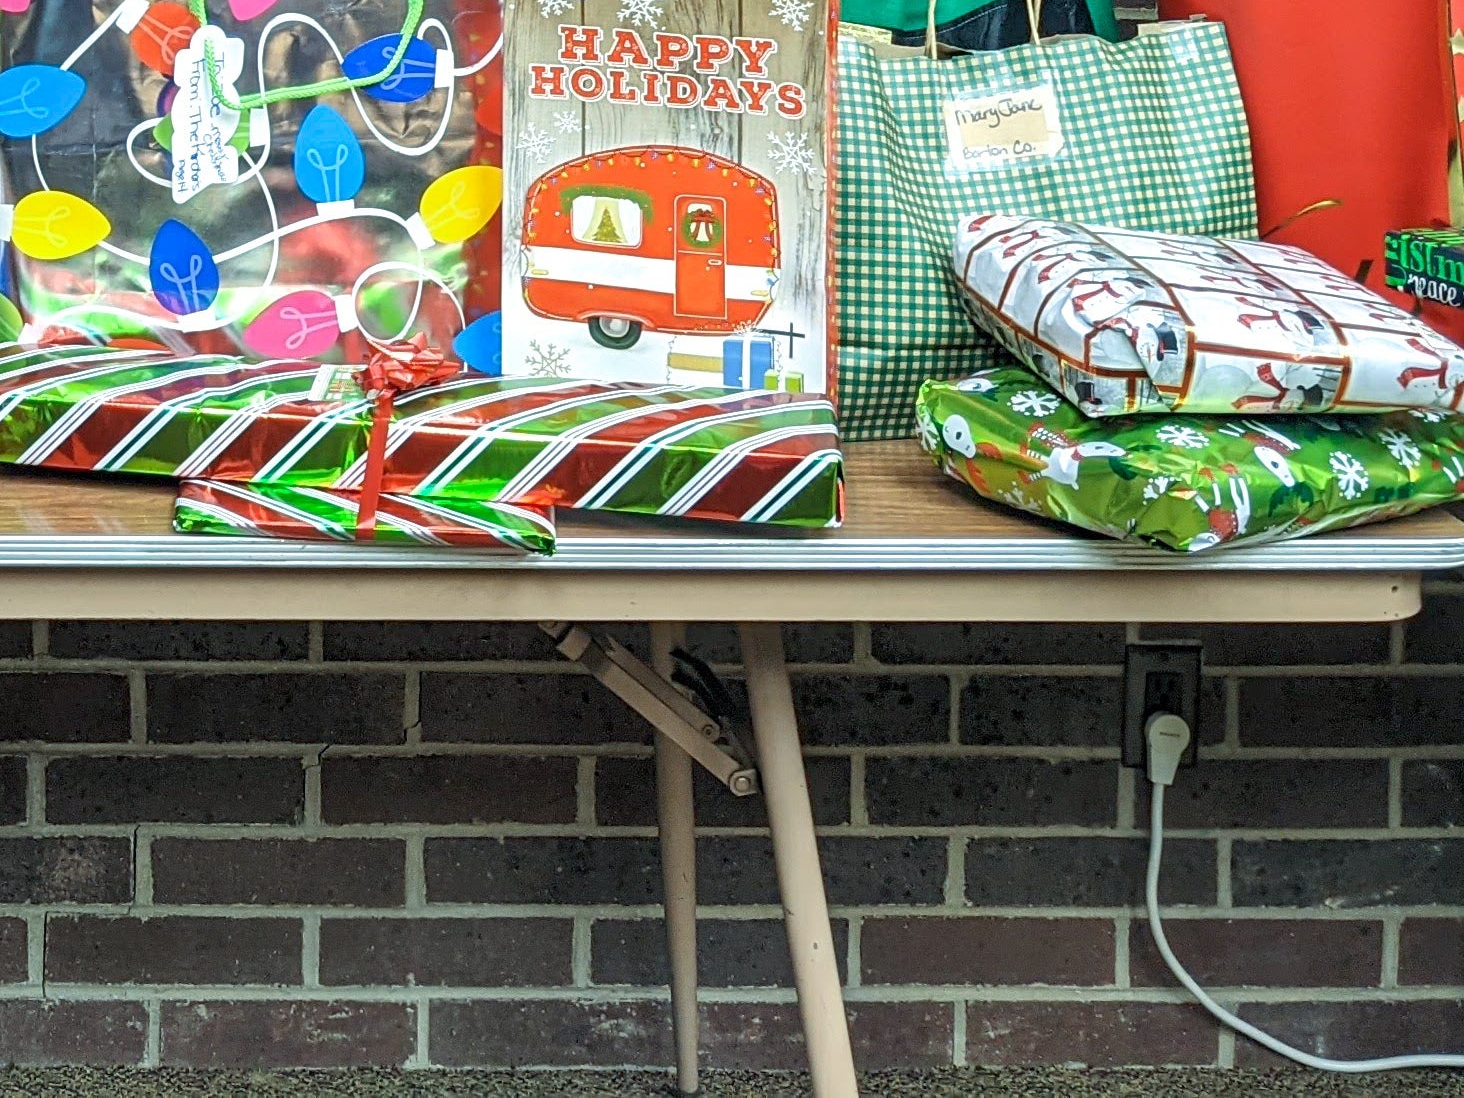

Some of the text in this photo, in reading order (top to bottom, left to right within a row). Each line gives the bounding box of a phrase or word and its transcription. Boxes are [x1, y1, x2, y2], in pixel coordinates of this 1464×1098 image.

[559, 24, 777, 77] HAPPY
[529, 63, 807, 119] HOLIDAYS
[1013, 139, 1036, 154] Co.
